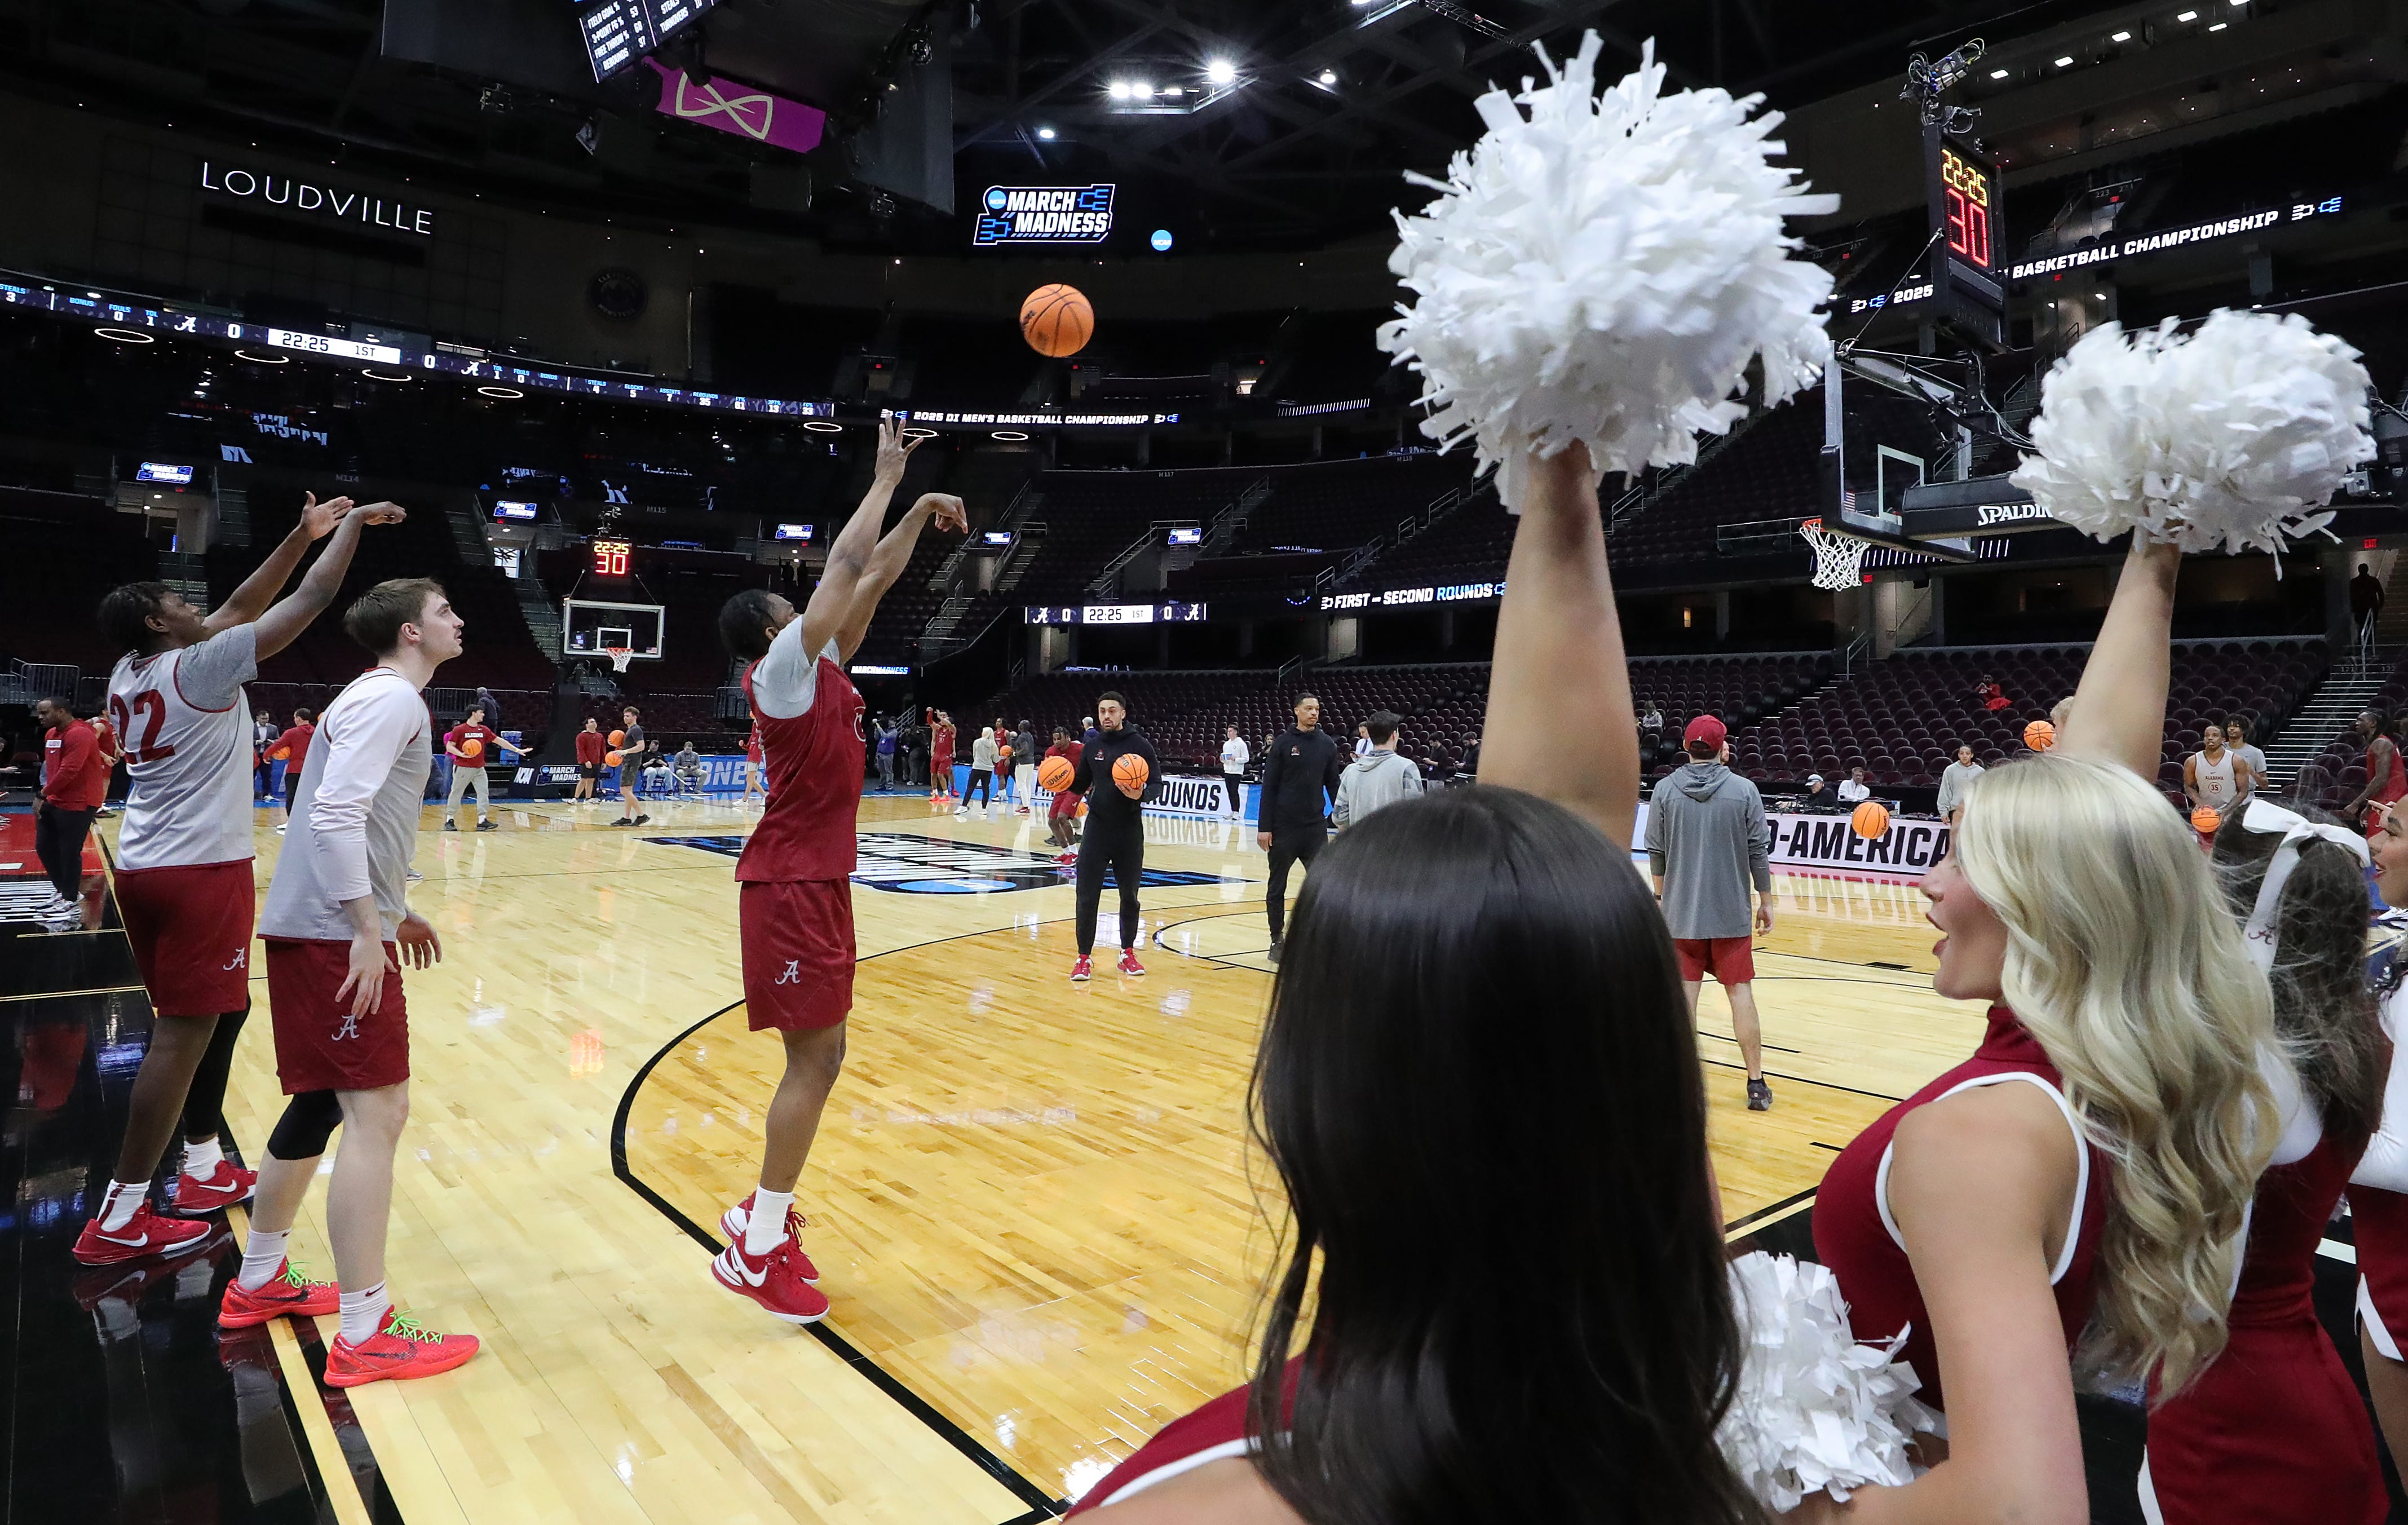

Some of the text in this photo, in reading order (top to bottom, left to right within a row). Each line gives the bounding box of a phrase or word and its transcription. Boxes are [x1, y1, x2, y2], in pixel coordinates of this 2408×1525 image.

[587, 13, 603, 29] FIELD
[601, 5, 616, 20] GOAL
[630, 6, 639, 18] 53
[660, 7, 688, 33] TURNOVERS
[594, 44, 608, 59] FREE
[606, 33, 624, 51] THROW
[603, 47, 629, 70] REBOUNDS
[202, 162, 432, 234] LOUDVILLE
[1006, 191, 1076, 211] MARCH
[1014, 212, 1108, 233] MADNESS
[1947, 188, 1989, 267] 30
[2013, 210, 2278, 279] BASKETBALL CHAMPIONSHIP
[0, 284, 26, 294] STEALS
[69, 297, 95, 307] BONUS
[108, 304, 131, 313] FOULS
[6, 291, 16, 302] 3
[1893, 284, 1934, 304] 2025
[114, 311, 154, 326] 0 1
[227, 324, 241, 339] 0
[282, 333, 329, 351] 22:25
[355, 345, 377, 357] 1ST
[424, 355, 436, 369] 0
[494, 371, 500, 379] 1
[518, 374, 524, 383] 0
[768, 404, 779, 413] 13
[802, 406, 813, 415] 33
[913, 412, 1149, 425] 2025 DI MEN'S BASKETBALL CHAMPIONSHIP
[594, 541, 629, 555] 22:25
[595, 552, 626, 574] 30
[1334, 583, 1494, 609] FIRST SECOND ROUNDS
[1062, 608, 1071, 622] 0
[1089, 609, 1122, 621] 22:25
[1164, 606, 1172, 620] 0
[111, 689, 175, 764] 22
[1046, 769, 1068, 786] Wilson
[1146, 780, 1221, 811] OUNDS
